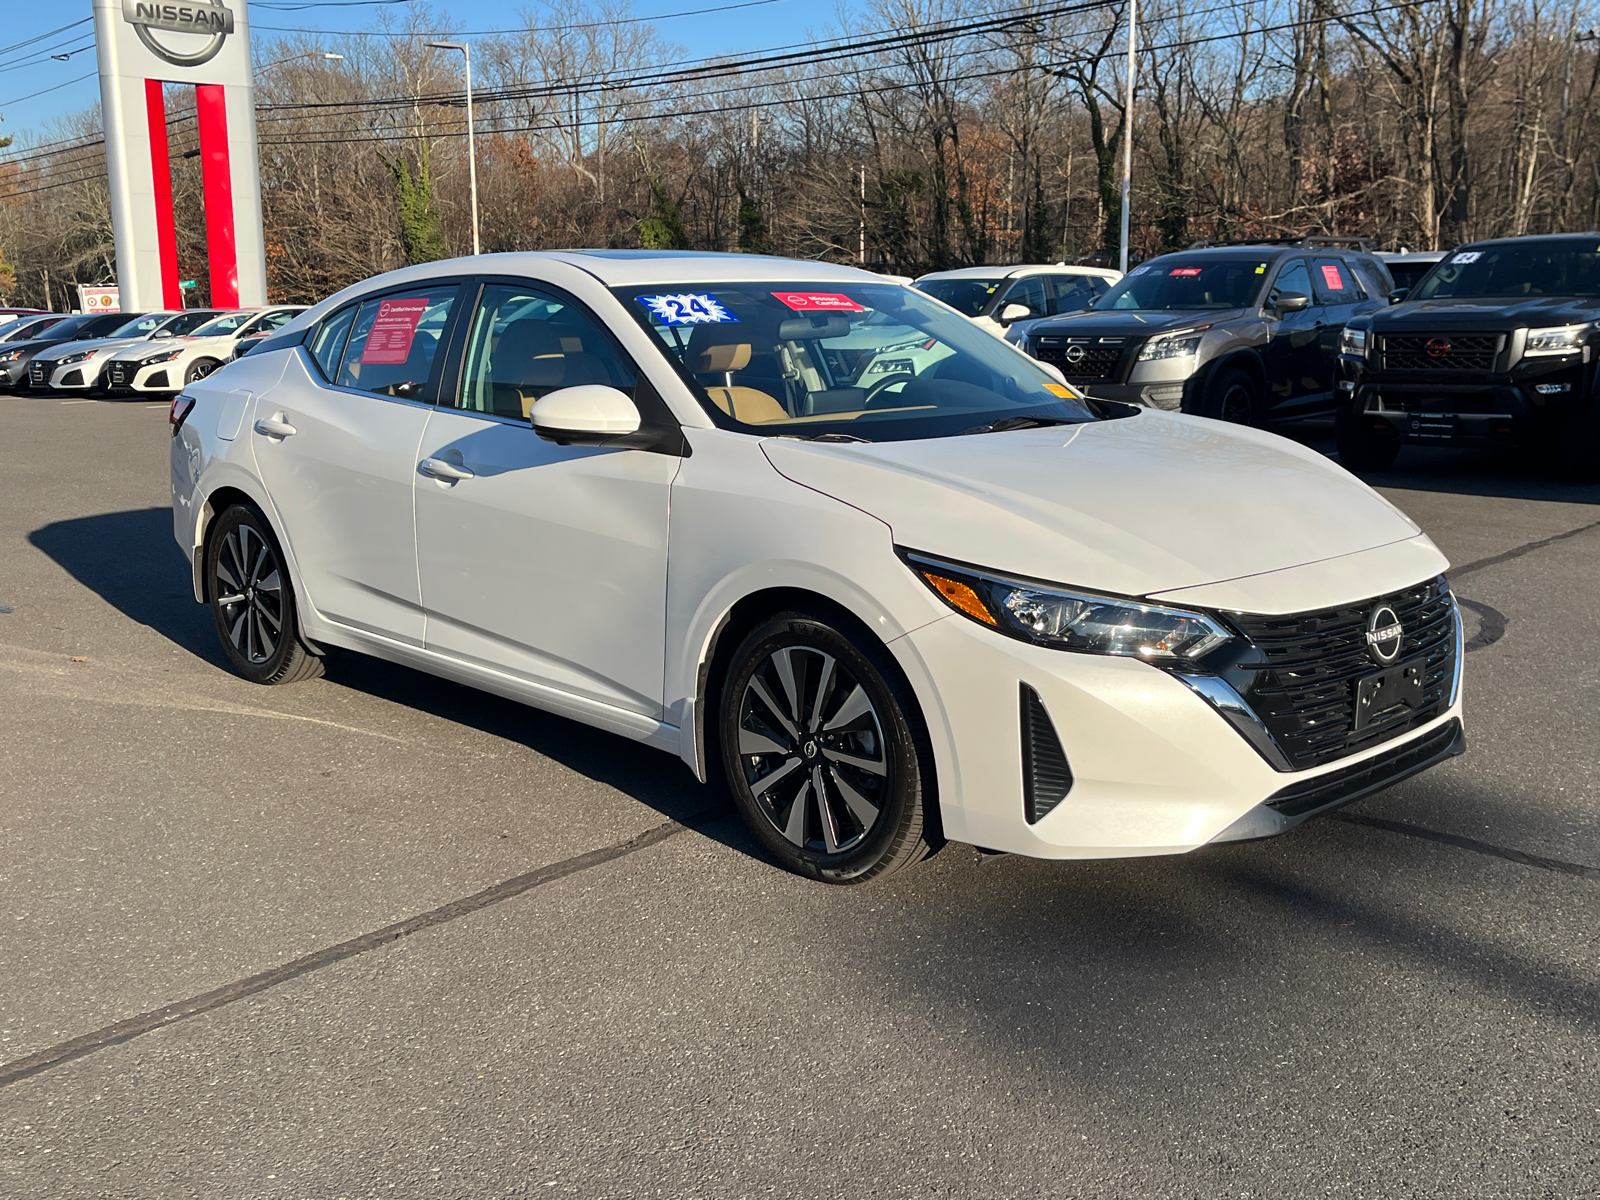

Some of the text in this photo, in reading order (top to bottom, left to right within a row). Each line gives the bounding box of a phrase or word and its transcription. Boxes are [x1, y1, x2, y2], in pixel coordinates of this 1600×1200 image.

[136, 3, 225, 27] NISSAN
[665, 298, 711, 317] 24
[1369, 624, 1402, 643] NISSAN
